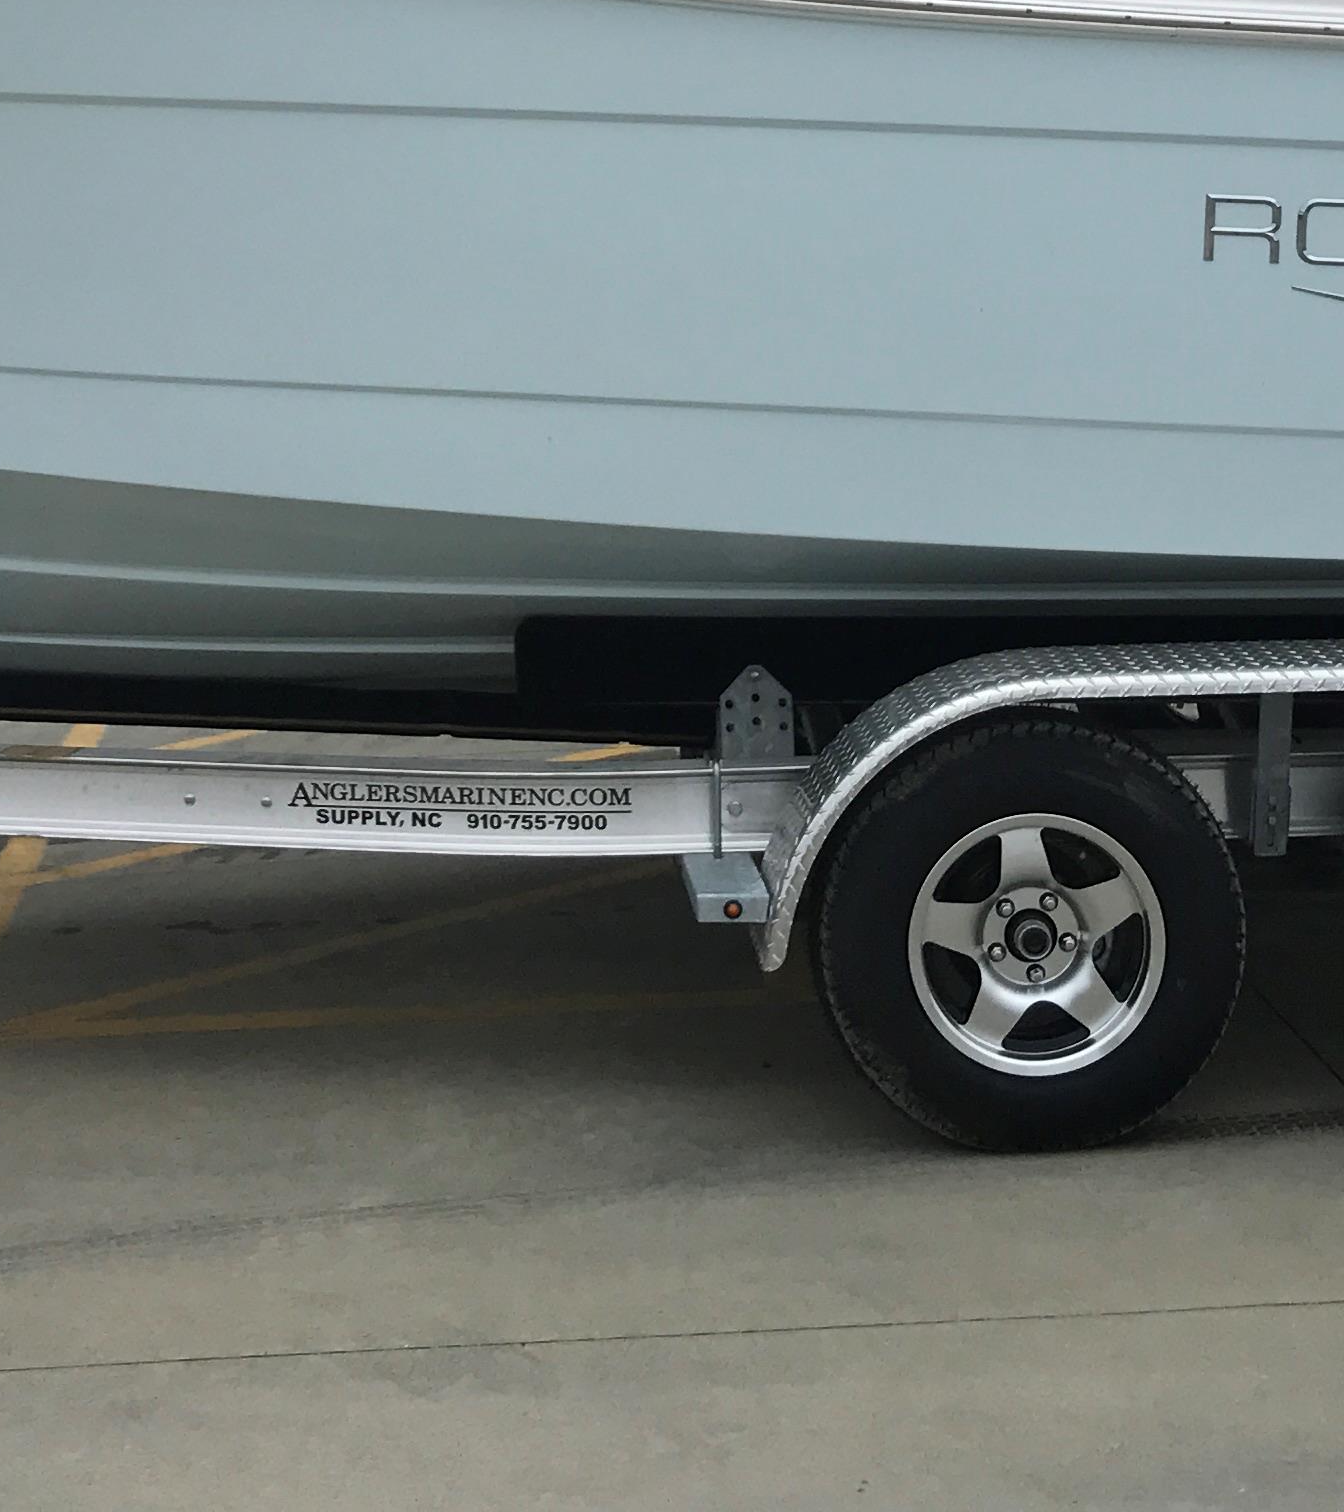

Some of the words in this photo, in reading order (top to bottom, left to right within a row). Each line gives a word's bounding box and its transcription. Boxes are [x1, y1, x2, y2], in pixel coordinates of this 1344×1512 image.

[287, 781, 633, 808] ANGLERSMARINENC.COM
[315, 808, 405, 828] SUPPLY,
[410, 812, 444, 829] NC
[466, 813, 609, 831] 910-755-7900
